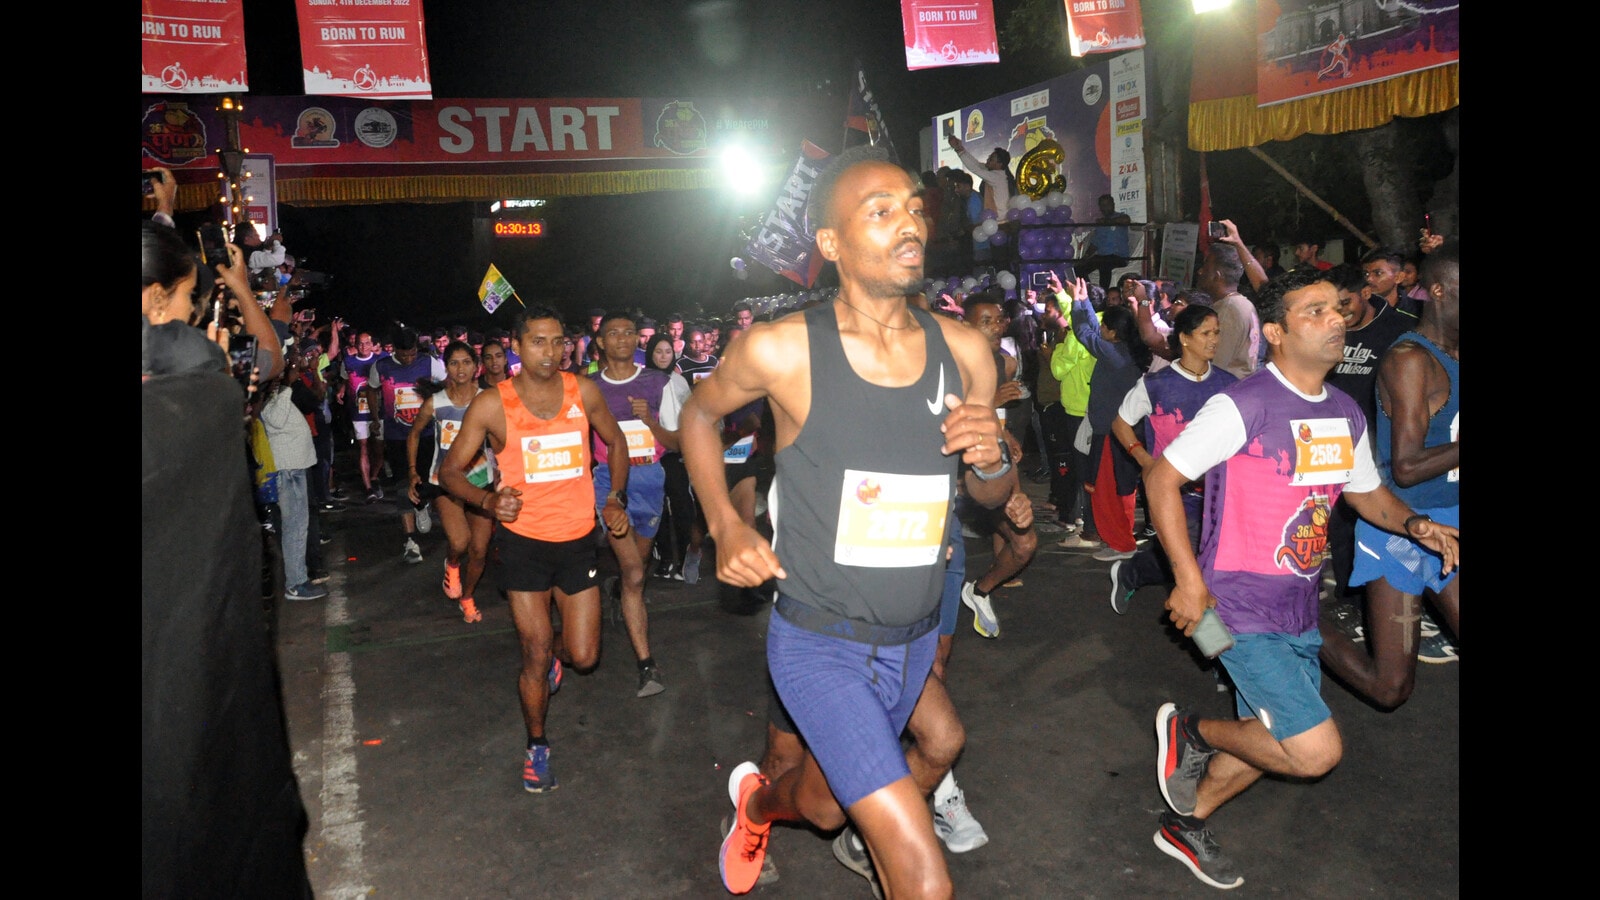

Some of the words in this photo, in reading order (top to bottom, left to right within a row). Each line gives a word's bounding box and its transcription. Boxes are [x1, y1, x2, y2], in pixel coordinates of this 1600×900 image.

[1074, 1, 1095, 12] BORN
[1096, 0, 1108, 10] TO
[1110, 0, 1126, 9] RUN
[919, 11, 944, 22] BORN
[946, 11, 957, 21] TO
[959, 9, 977, 20] RUN
[142, 21, 166, 36] RN
[169, 23, 188, 38] TO
[192, 25, 222, 39] RUN
[321, 27, 356, 41] BORN
[359, 27, 376, 40] TO
[380, 27, 405, 40] RUN
[1117, 80, 1137, 93] INOX
[437, 105, 620, 154] START
[1119, 190, 1140, 202] WERT
[758, 156, 819, 252] START
[495, 222, 542, 235] 0:30:13
[728, 443, 746, 456] 3044
[1309, 443, 1342, 466] 2582
[537, 450, 571, 469] 2360
